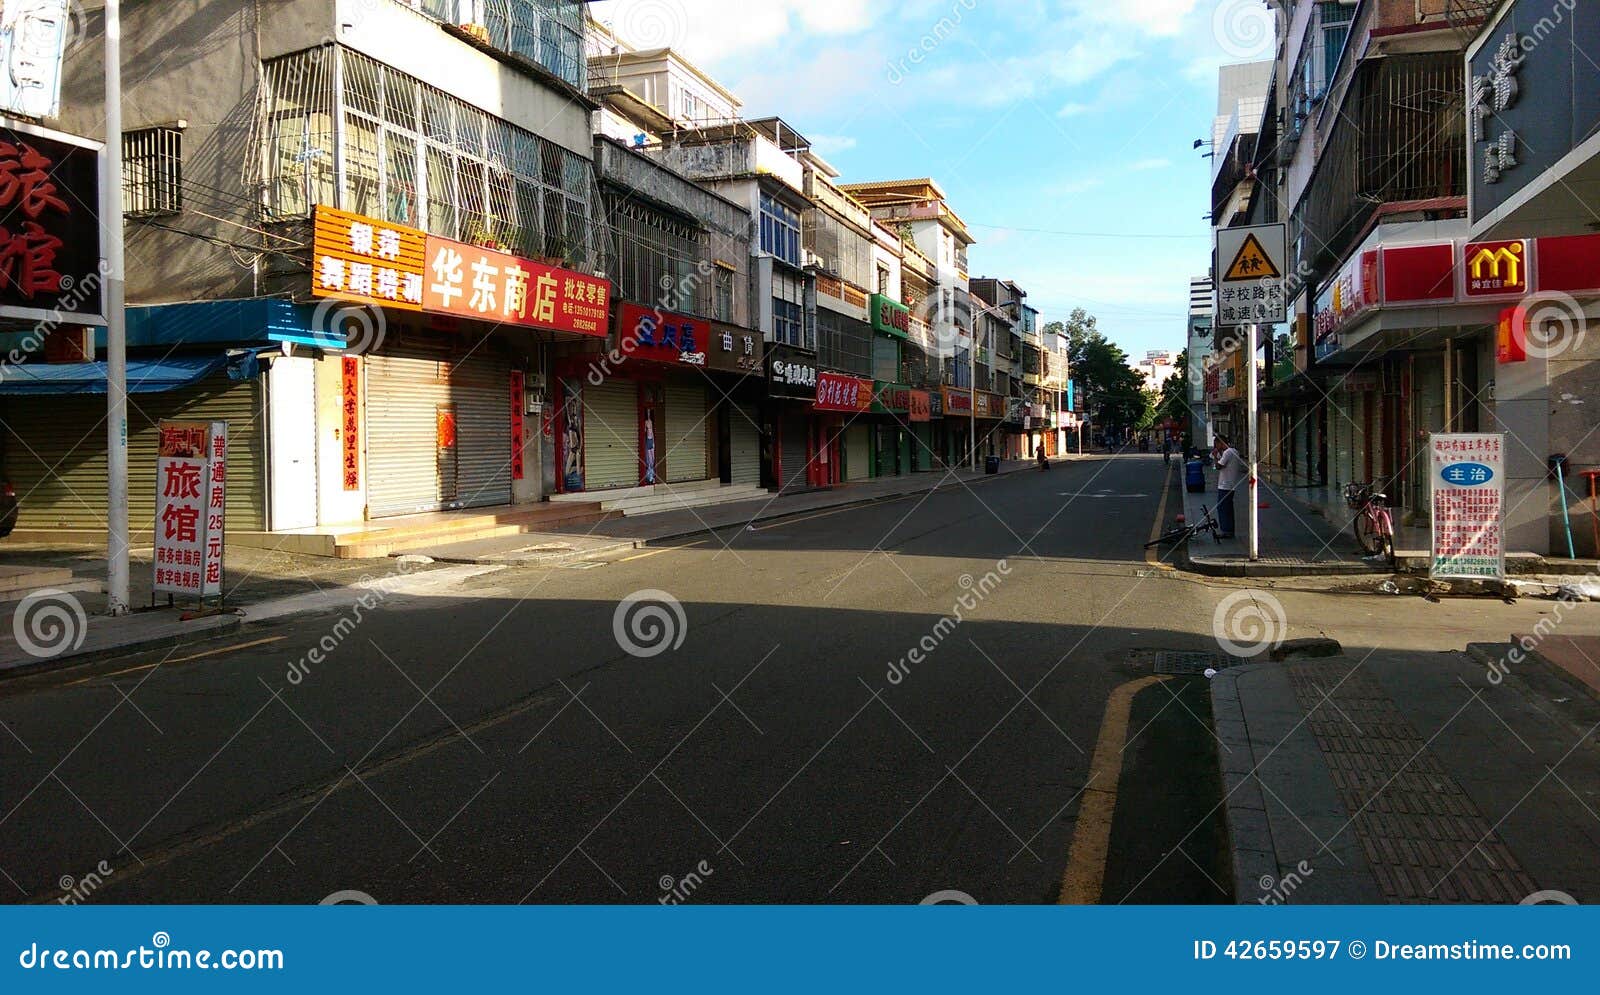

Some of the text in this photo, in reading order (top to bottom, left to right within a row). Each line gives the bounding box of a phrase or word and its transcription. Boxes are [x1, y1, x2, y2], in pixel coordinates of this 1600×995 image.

[431, 245, 559, 324] 华东商店
[564, 277, 606, 306] 批发零售
[1222, 284, 1281, 302] 学校路段
[1222, 303, 1282, 321] 减速慢行
[1449, 468, 1486, 481] 主治
[162, 461, 201, 543] 旅馆
[205, 435, 226, 584] 普通房25元起
[156, 547, 201, 567] 商务电脑房
[156, 568, 200, 589] 数字电视房
